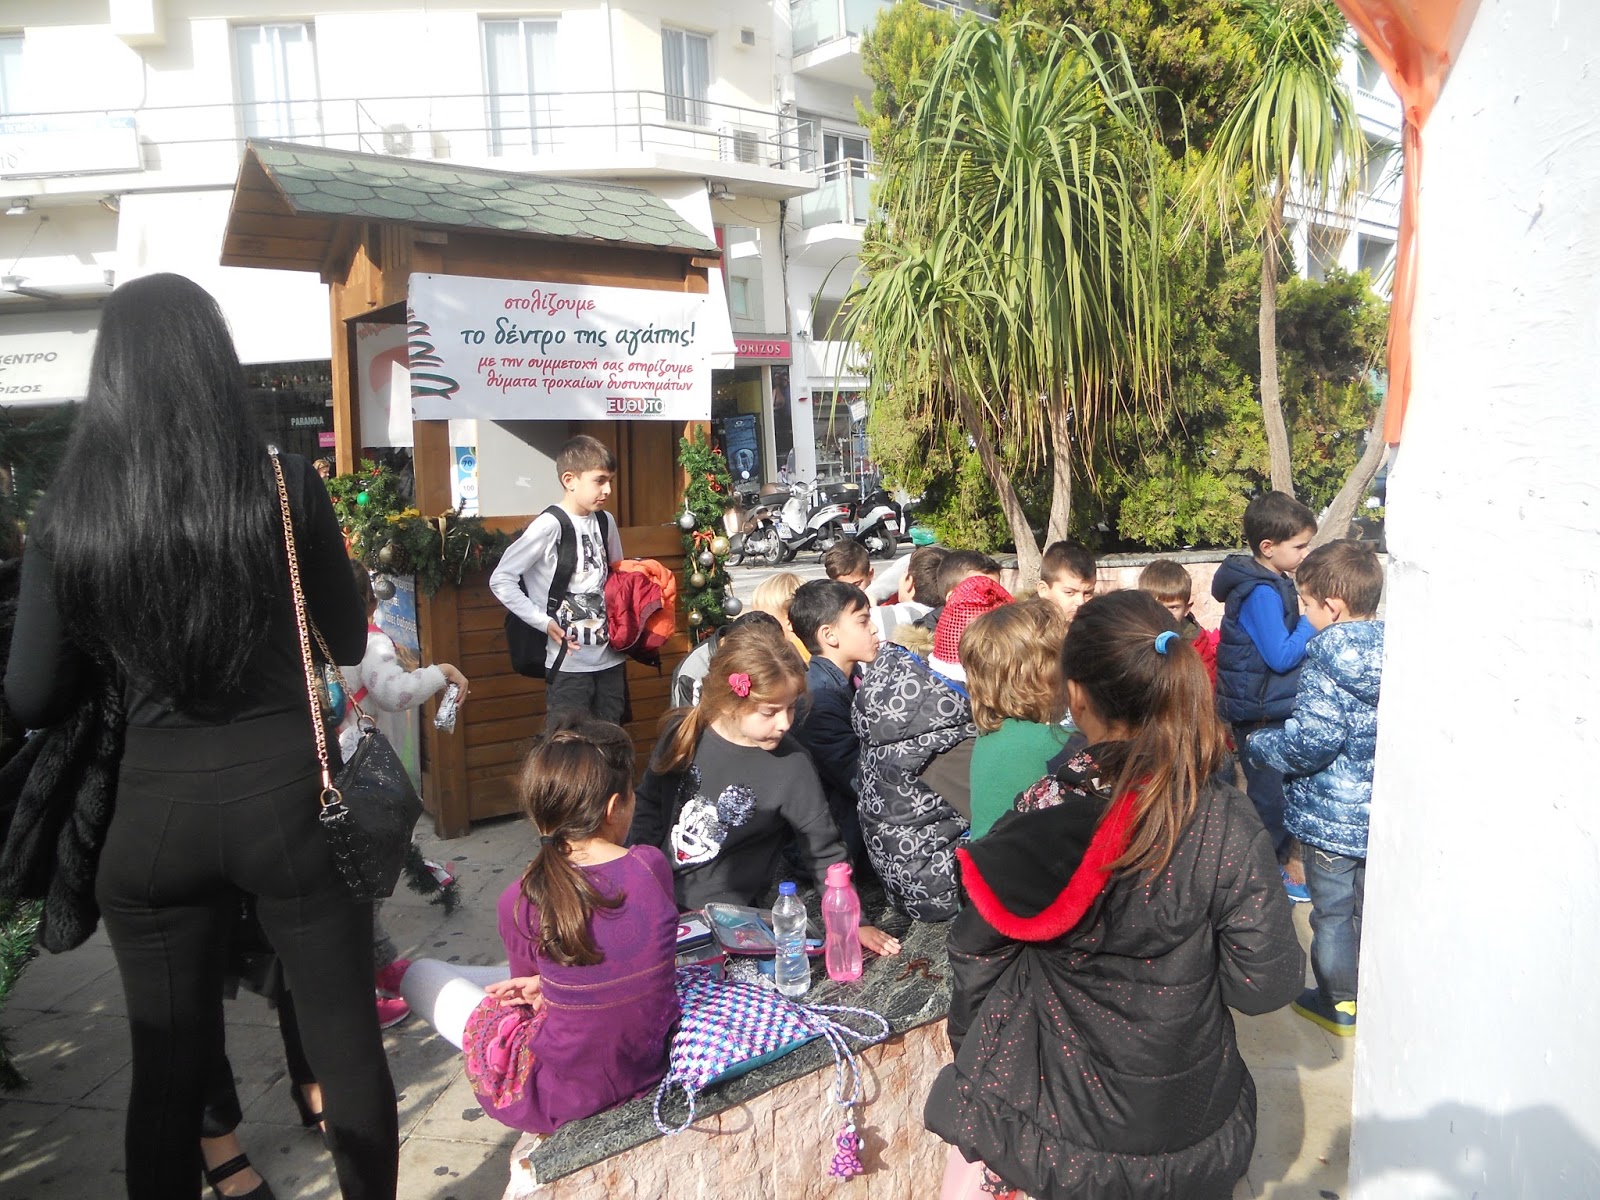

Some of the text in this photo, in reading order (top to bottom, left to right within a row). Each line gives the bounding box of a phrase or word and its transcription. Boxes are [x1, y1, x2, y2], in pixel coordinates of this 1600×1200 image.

[504, 289, 596, 319] στολίζουμε
[460, 316, 696, 356] το δέντρο της αγάπης!
[735, 343, 782, 355] ORIZOS
[477, 357, 694, 380] με την συμμετοχή σας στηρίζουμε
[486, 368, 694, 397] θύματα τροχαίων δυστυχημάτων
